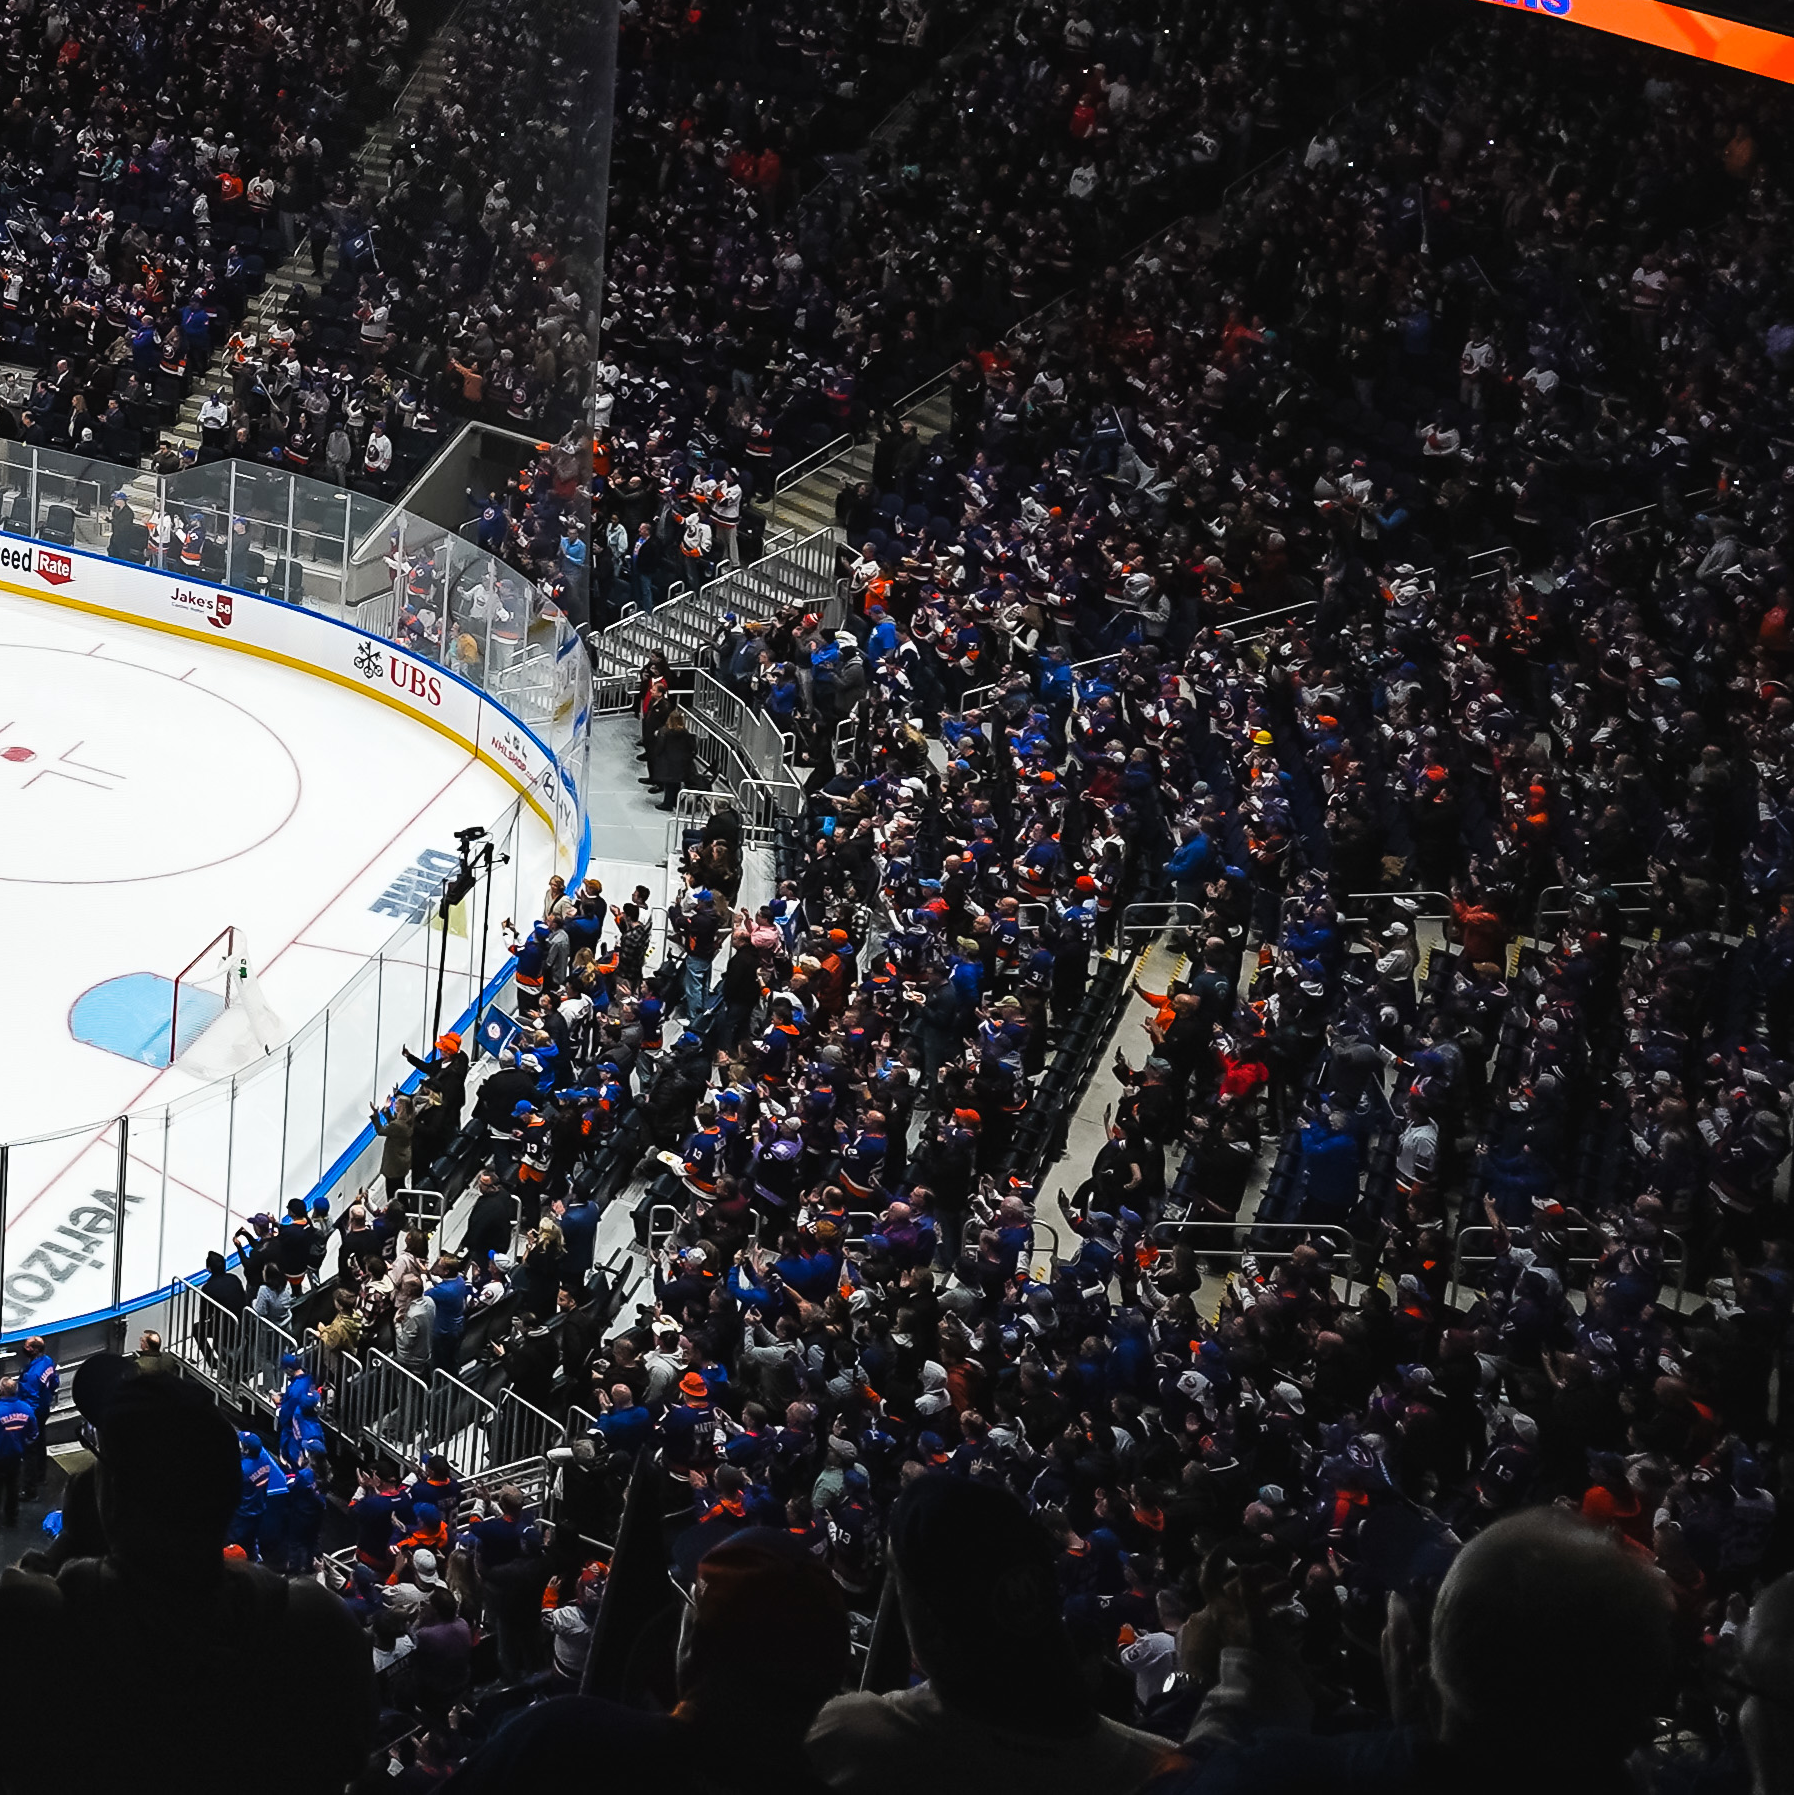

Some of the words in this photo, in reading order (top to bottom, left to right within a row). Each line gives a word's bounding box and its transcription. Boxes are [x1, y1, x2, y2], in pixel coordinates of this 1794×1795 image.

[39, 553, 70, 577] Rate
[171, 588, 214, 609] Jake's
[389, 656, 442, 706] UBS
